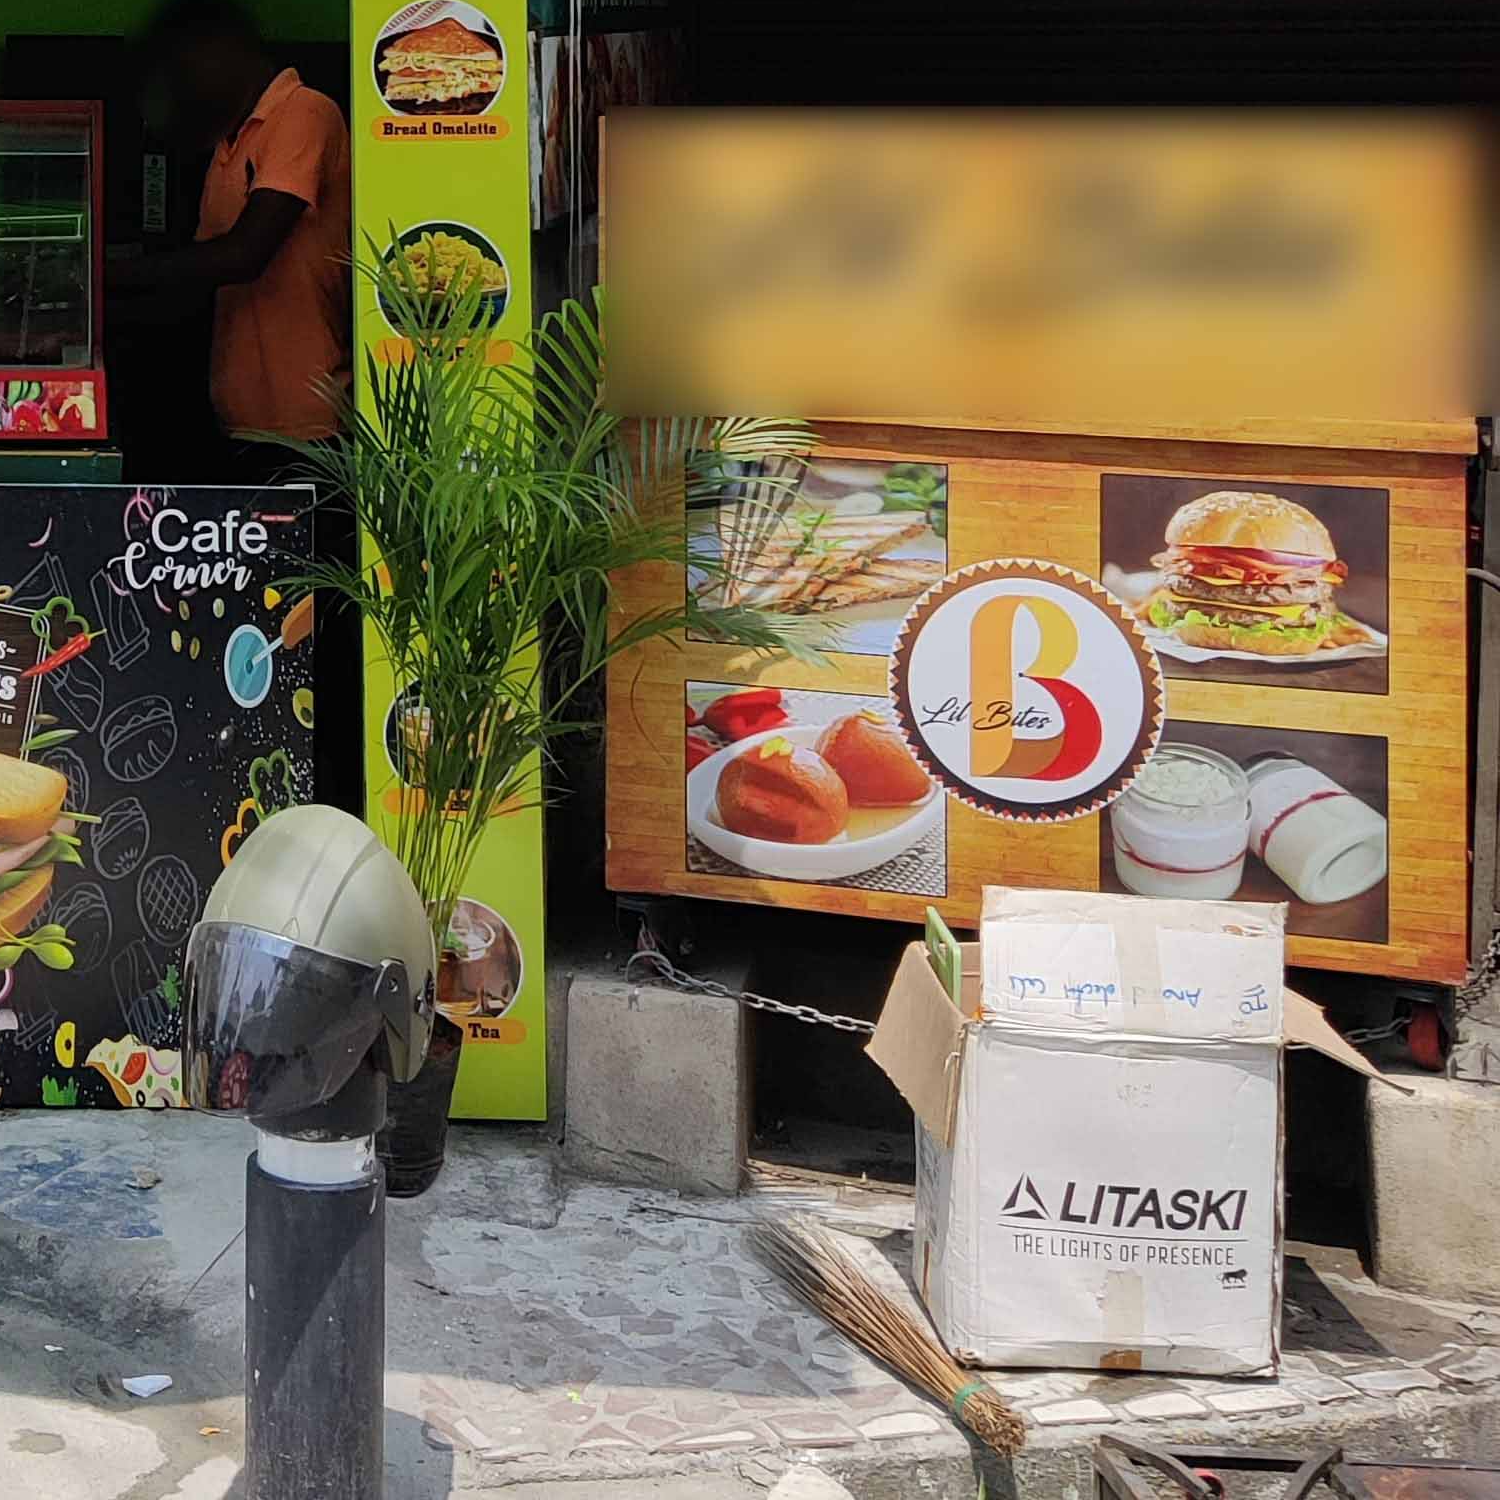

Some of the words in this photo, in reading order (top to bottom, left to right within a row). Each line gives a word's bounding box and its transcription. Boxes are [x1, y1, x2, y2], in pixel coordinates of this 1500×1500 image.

[383, 122, 427, 136] Bread
[432, 121, 497, 136] Omelette
[106, 541, 253, 592] Corner
[920, 696, 972, 727] Lil
[973, 700, 1053, 731] Bites
[468, 1023, 501, 1039] Tea
[1058, 1180, 1249, 1232] LITASKI
[1012, 1234, 1045, 1256] THE
[1050, 1236, 1113, 1261] LIGHTS
[1119, 1242, 1140, 1263] OF
[1146, 1243, 1235, 1267] PRESENCE
